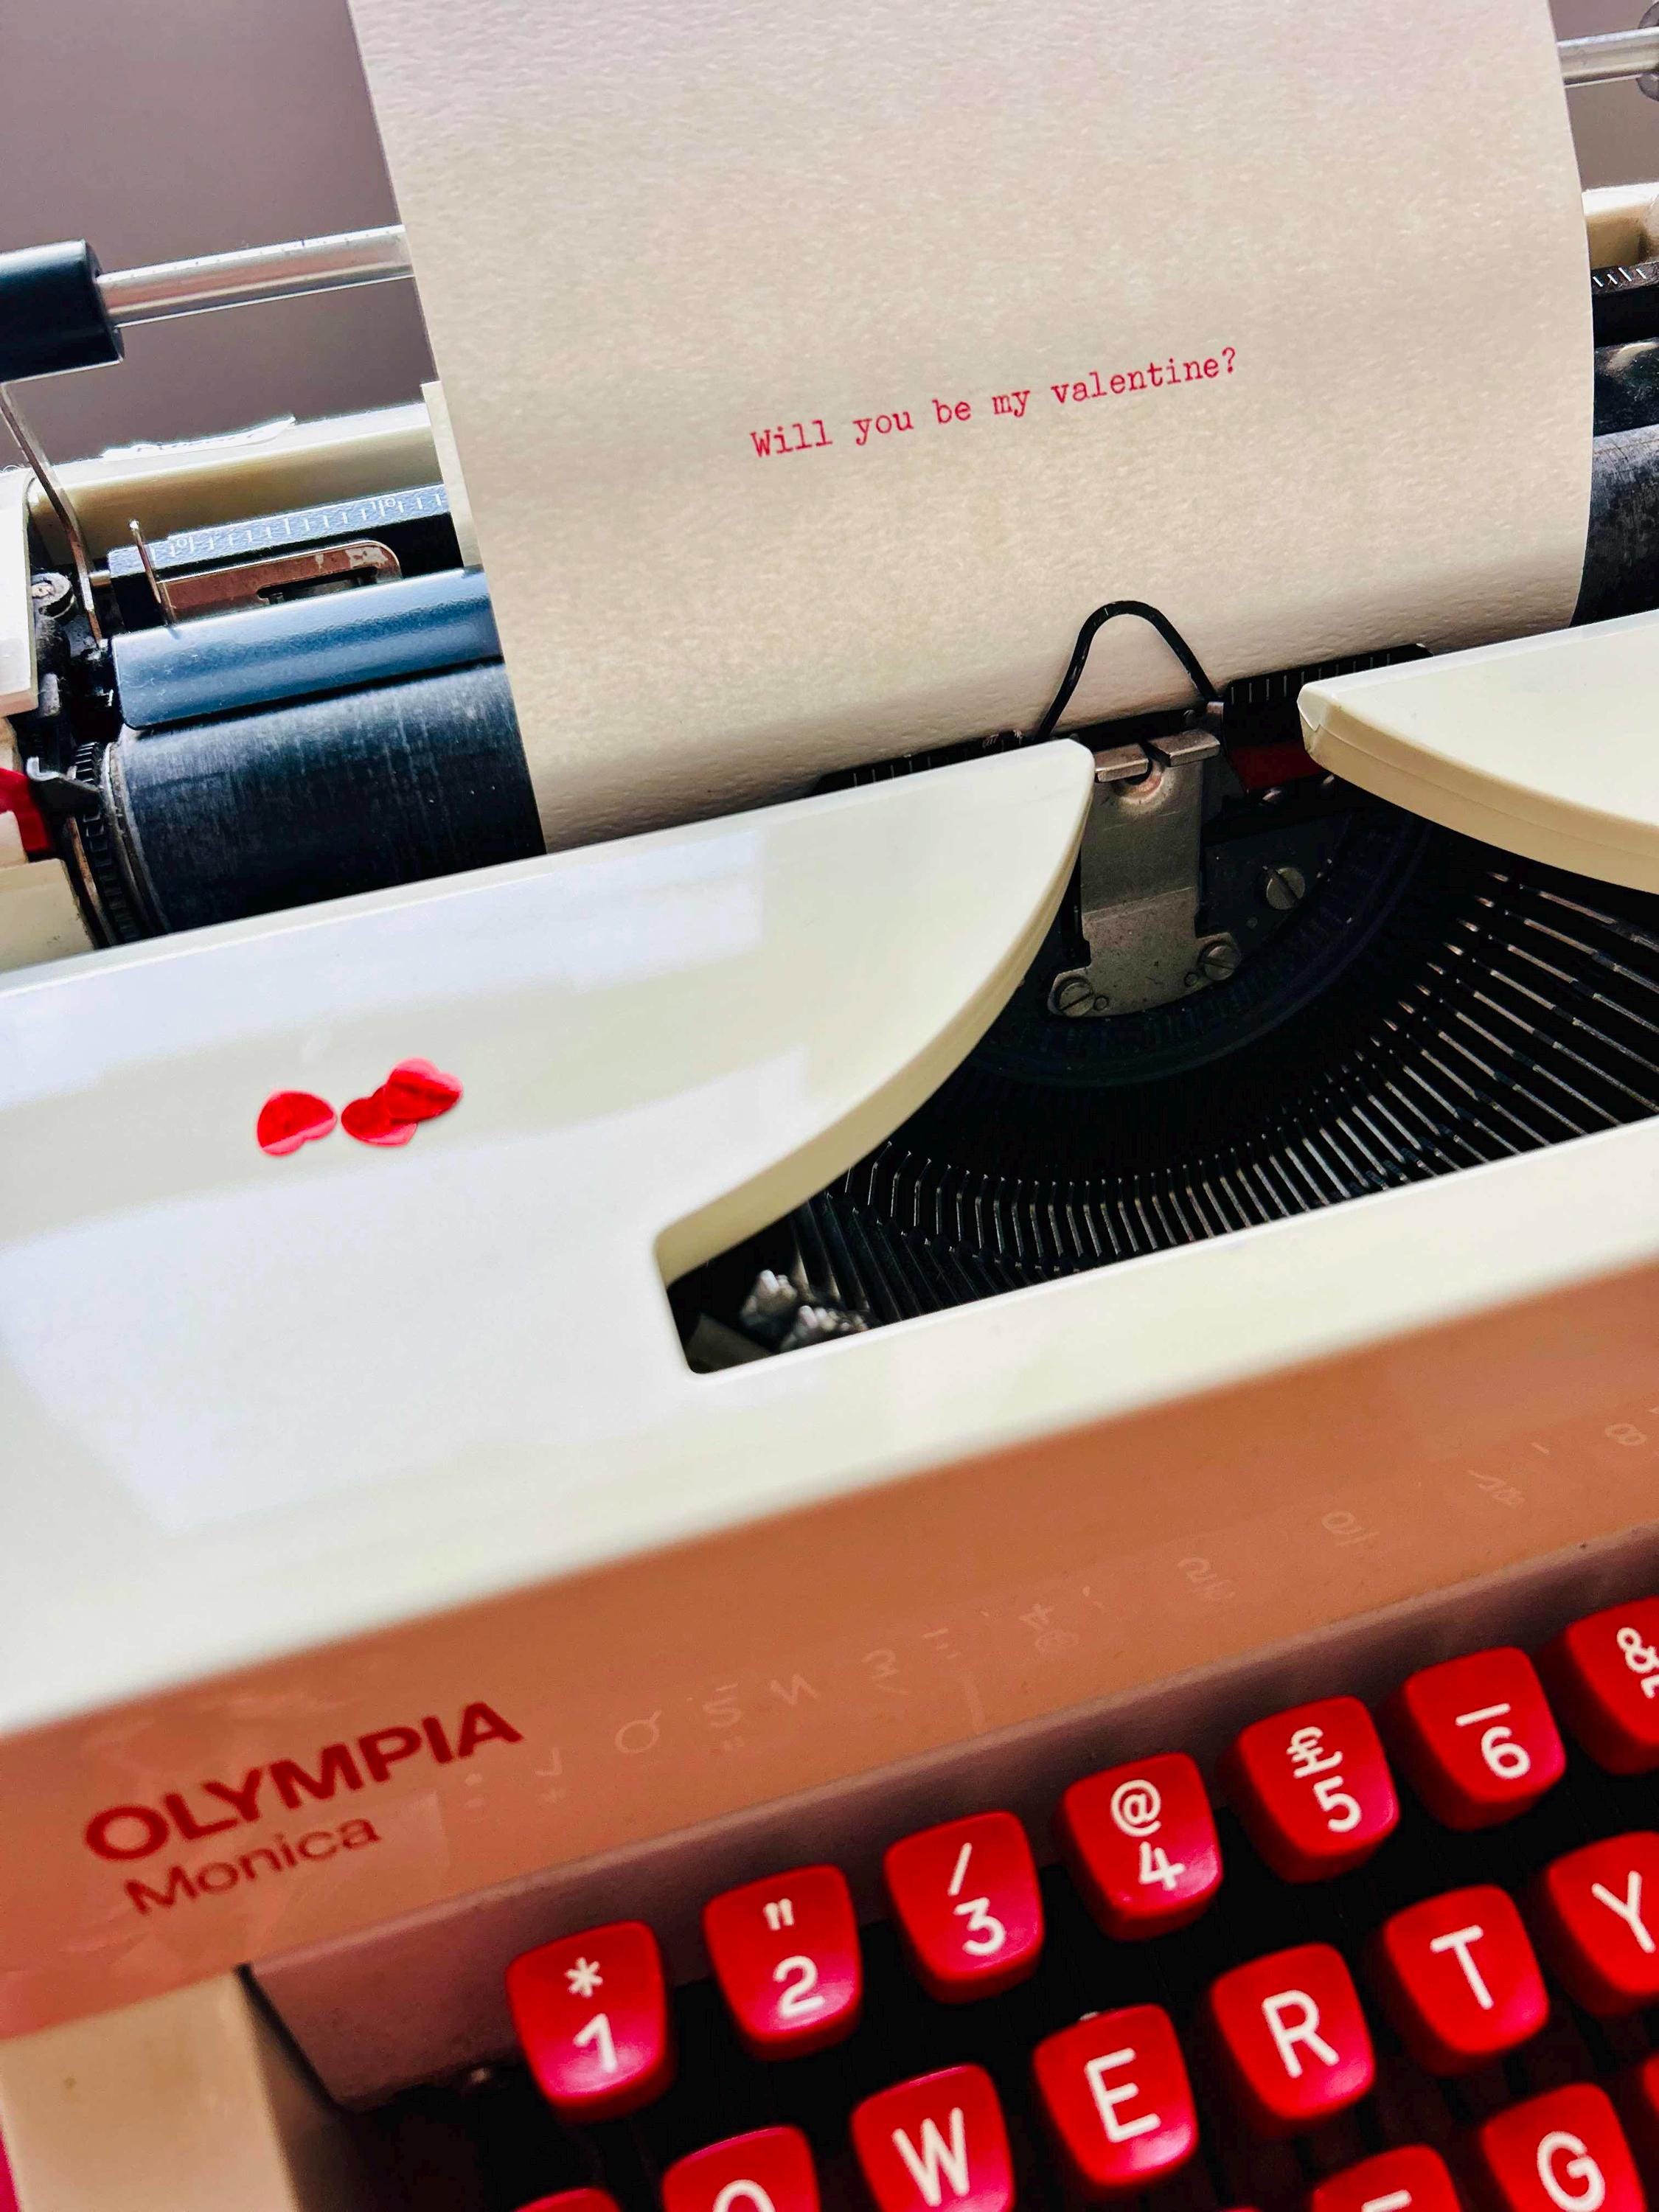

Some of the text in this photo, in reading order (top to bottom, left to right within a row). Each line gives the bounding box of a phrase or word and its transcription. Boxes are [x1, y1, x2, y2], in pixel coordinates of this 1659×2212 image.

[750, 347, 1237, 457] Will you be my valentine?
[1616, 1627, 1659, 1674] &
[83, 1701, 524, 1862] OLYMPIA
[1286, 1726, 1343, 1778] £
[1481, 1726, 1531, 1779] 6
[1110, 1779, 1162, 1837] @
[1312, 1776, 1362, 1832] 5
[124, 1818, 381, 1916] Monica
[1139, 1842, 1185, 1891] 4
[954, 1896, 1005, 1955] 3
[1591, 1871, 1656, 1954] Y
[773, 1955, 826, 2019] 2
[1430, 1925, 1494, 2010] T
[574, 2013, 618, 2073] 1
[1262, 1990, 1340, 2079] R
[1084, 2048, 1161, 2143] E
[891, 2107, 970, 2207] W
[1537, 2131, 1606, 2212] G
